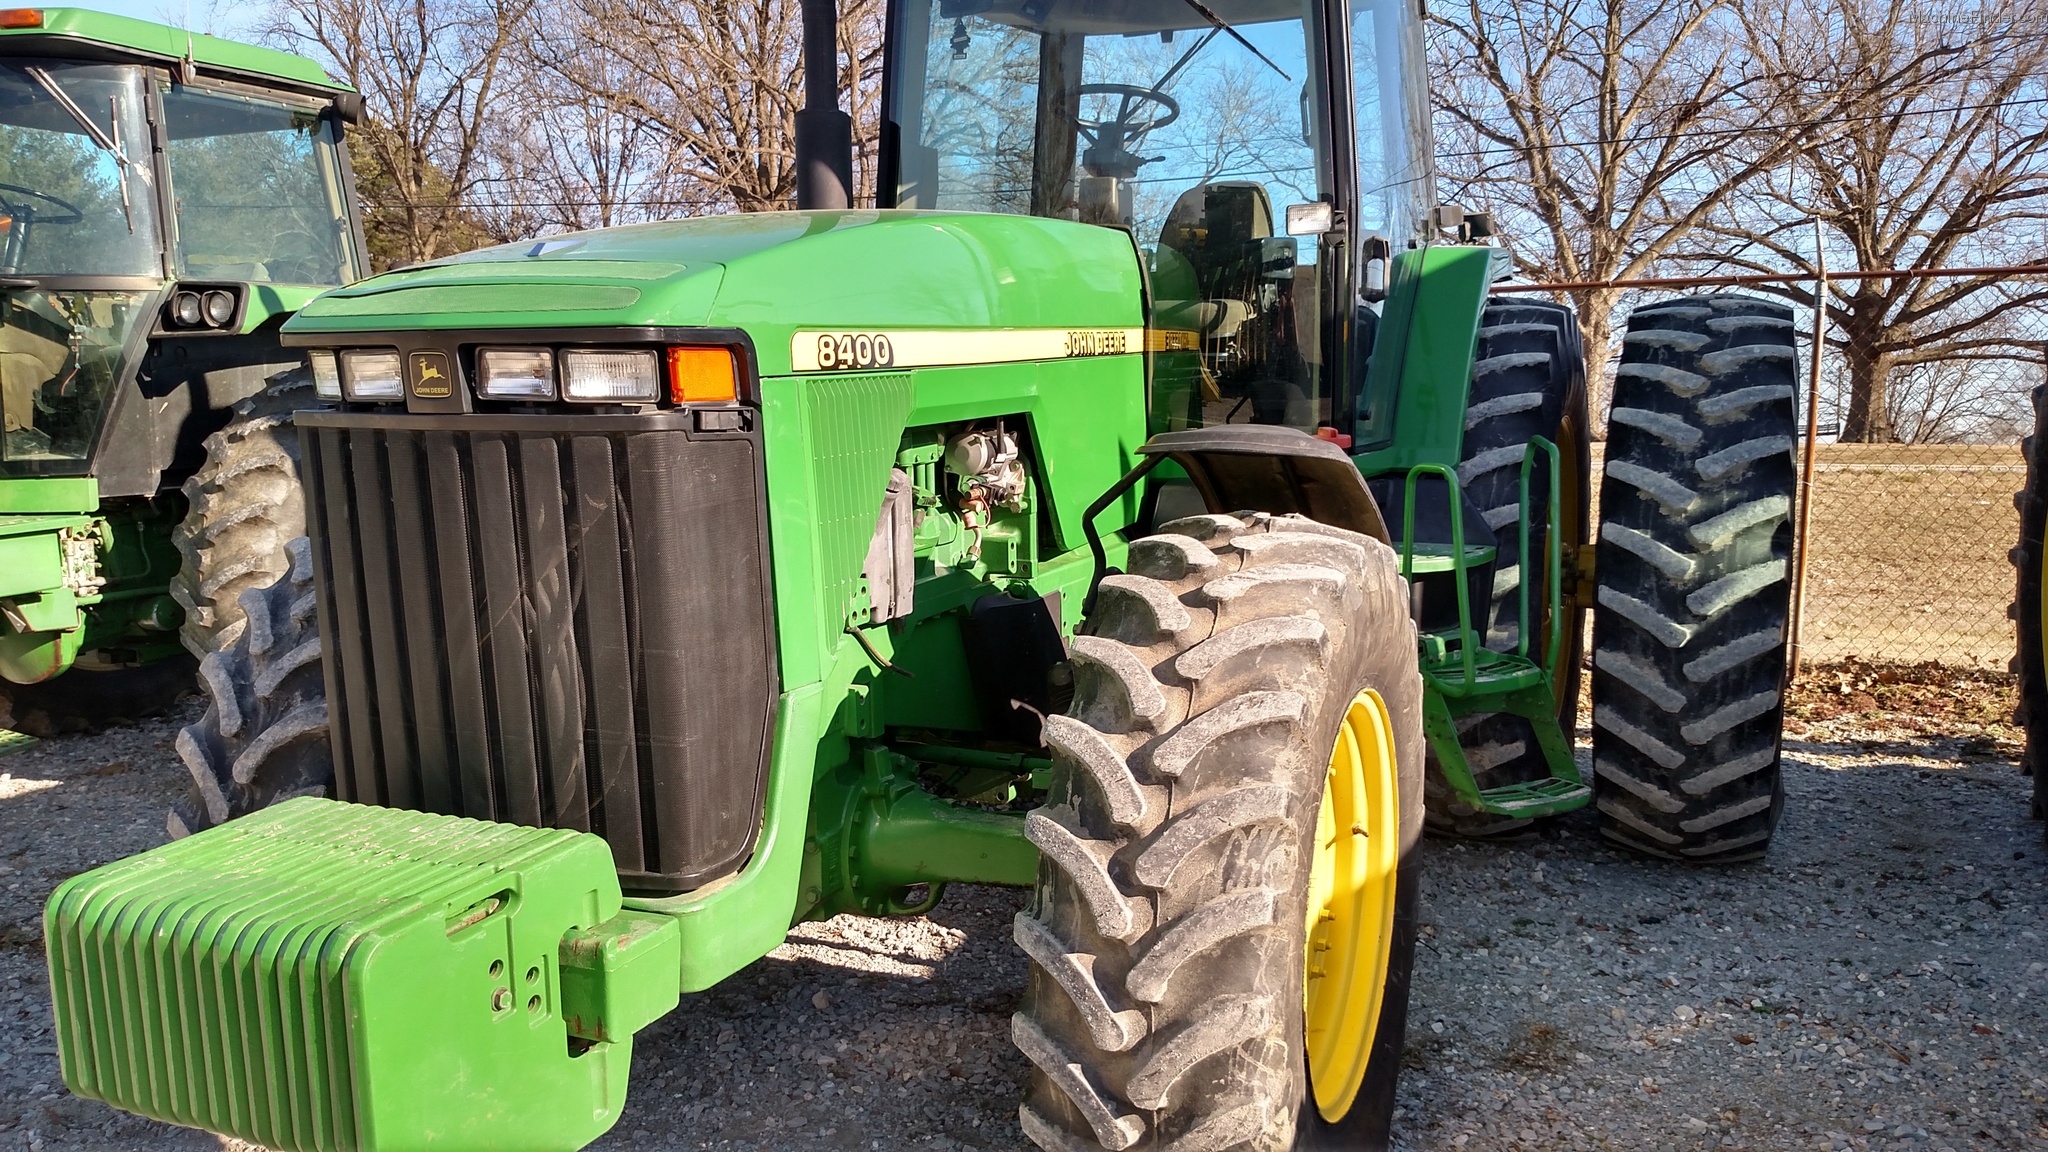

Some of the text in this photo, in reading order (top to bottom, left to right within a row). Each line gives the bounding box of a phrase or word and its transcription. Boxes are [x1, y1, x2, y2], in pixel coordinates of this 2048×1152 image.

[818, 334, 894, 369] 8400
[1064, 331, 1126, 357] JOHN DEERE
